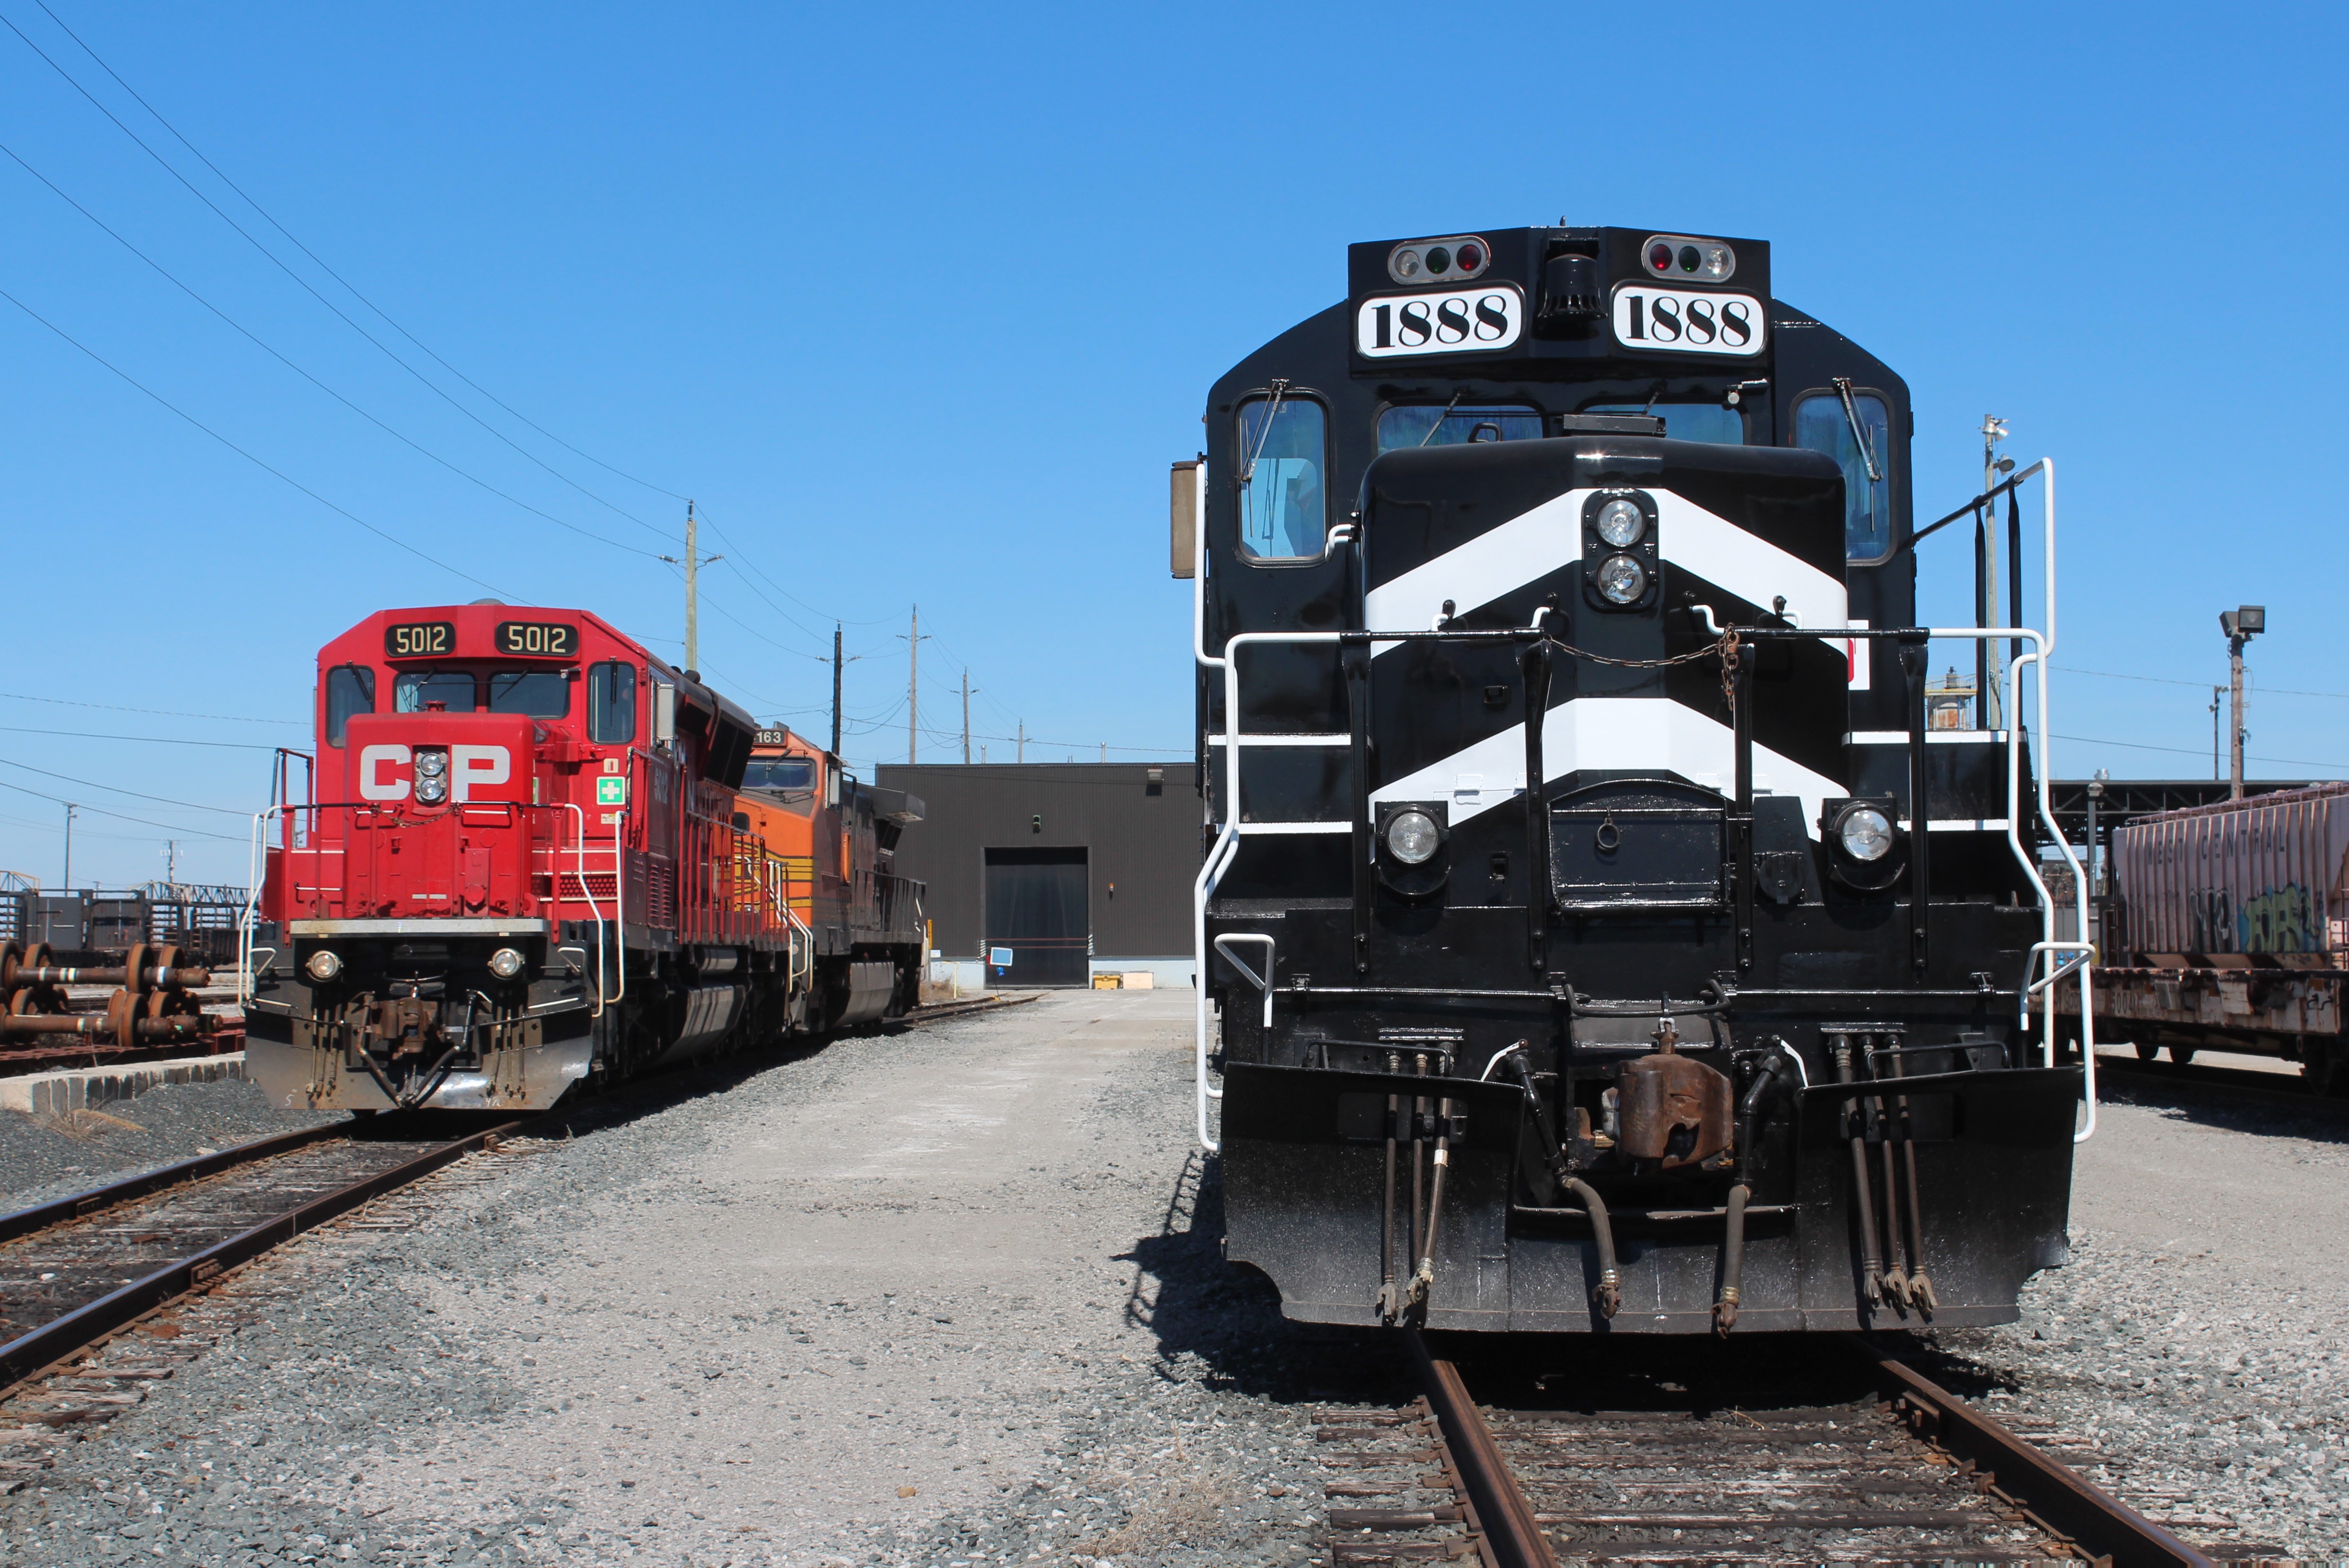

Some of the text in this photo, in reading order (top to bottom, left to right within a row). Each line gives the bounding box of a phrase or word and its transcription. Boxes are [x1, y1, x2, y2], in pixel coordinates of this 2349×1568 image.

[1371, 295, 1508, 349] 1888
[1625, 296, 1751, 347] 1888
[396, 626, 446, 653] 5012
[508, 626, 566, 653] 5012
[754, 731, 781, 743] 163
[359, 744, 510, 801] CP
[2147, 826, 2285, 865] WEST CENTRAL
